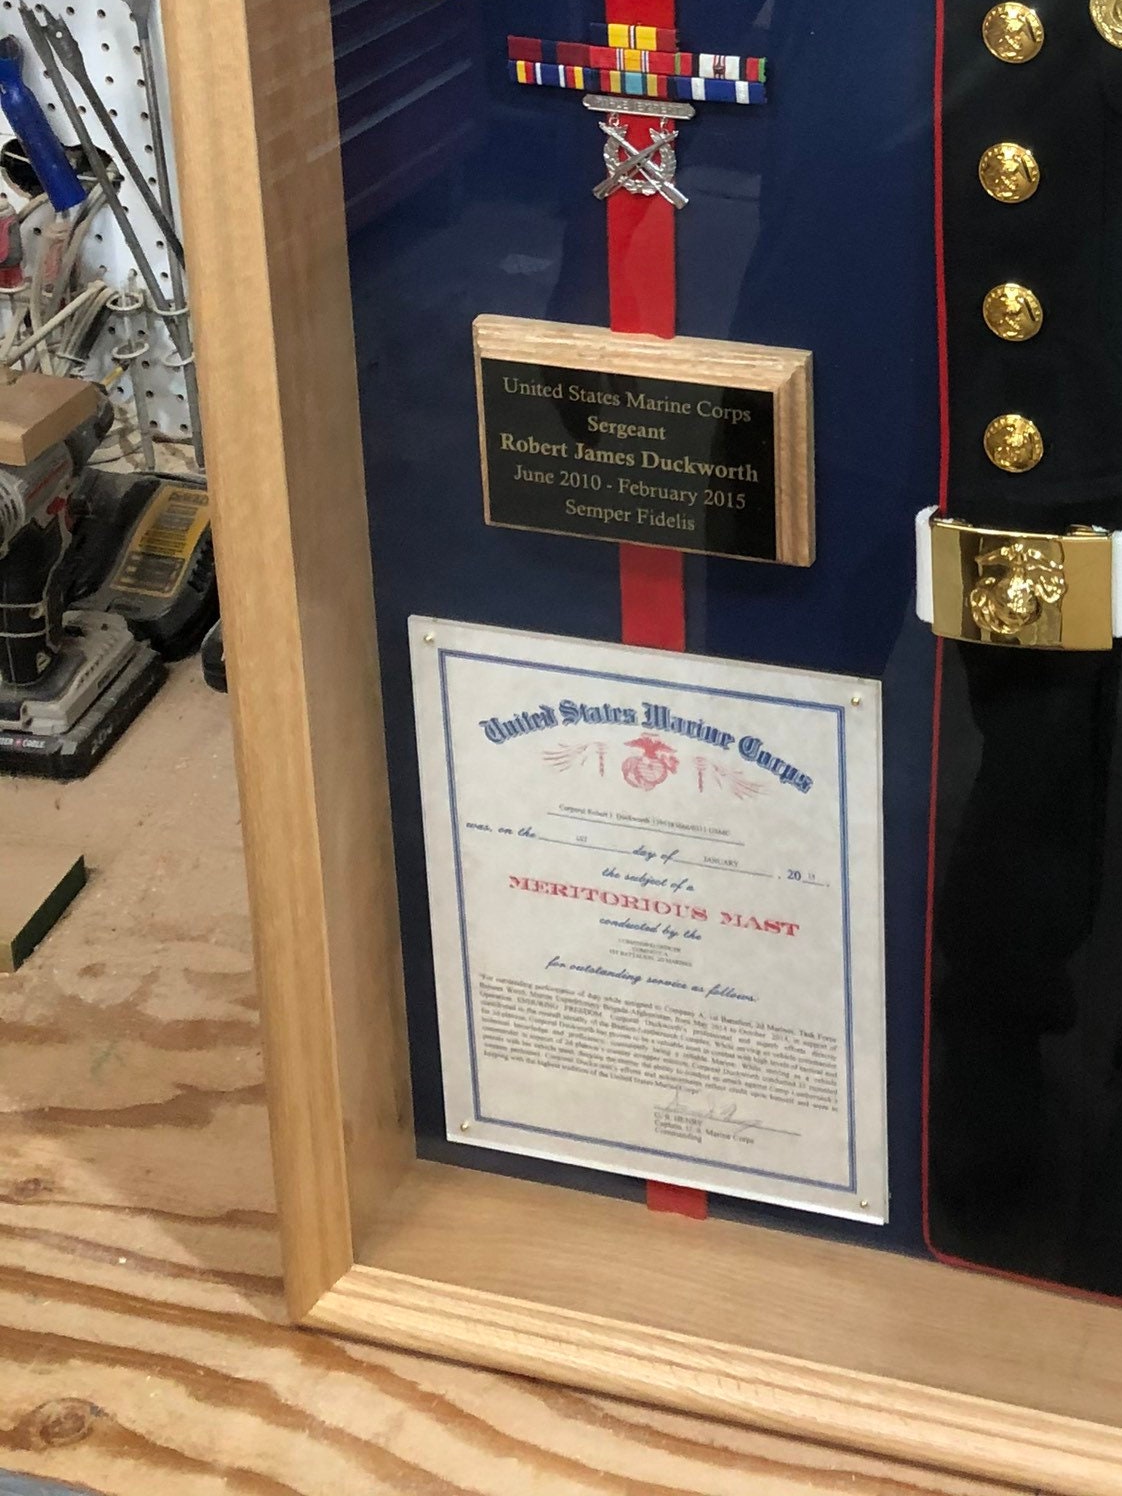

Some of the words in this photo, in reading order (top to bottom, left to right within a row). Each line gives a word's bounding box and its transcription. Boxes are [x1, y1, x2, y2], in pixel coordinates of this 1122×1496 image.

[502, 377, 563, 400] United
[569, 384, 620, 407] States
[626, 391, 691, 416] Marine
[697, 401, 751, 423] Corps
[587, 416, 666, 441] Sergeant
[500, 432, 567, 458] Robert
[574, 442, 635, 467] James
[641, 451, 758, 483] Duckworth
[514, 465, 554, 486] June
[560, 471, 601, 490] 2010
[618, 478, 698, 507] February
[704, 490, 746, 510] 2015
[566, 500, 630, 524] Semper
[637, 509, 696, 531] Fidelis
[479, 704, 558, 745] United
[559, 699, 638, 726] States
[641, 702, 735, 750] Marine
[738, 735, 814, 794] Corps
[497, 827, 514, 835] on
[517, 826, 537, 838] the
[631, 844, 657, 862] day
[660, 848, 681, 865] of
[703, 855, 739, 868] JANUARY
[787, 868, 802, 882] 20
[601, 866, 621, 879] the
[623, 872, 669, 888] subject
[669, 877, 690, 893] of
[508, 875, 708, 922] MERITORIOUS
[720, 911, 800, 937] MAST
[599, 917, 662, 933] conducted
[660, 922, 680, 940] by
[683, 929, 702, 941] the
[544, 955, 567, 970] for
[568, 964, 643, 986] outstanding
[646, 976, 687, 990] service
[690, 985, 704, 993] as
